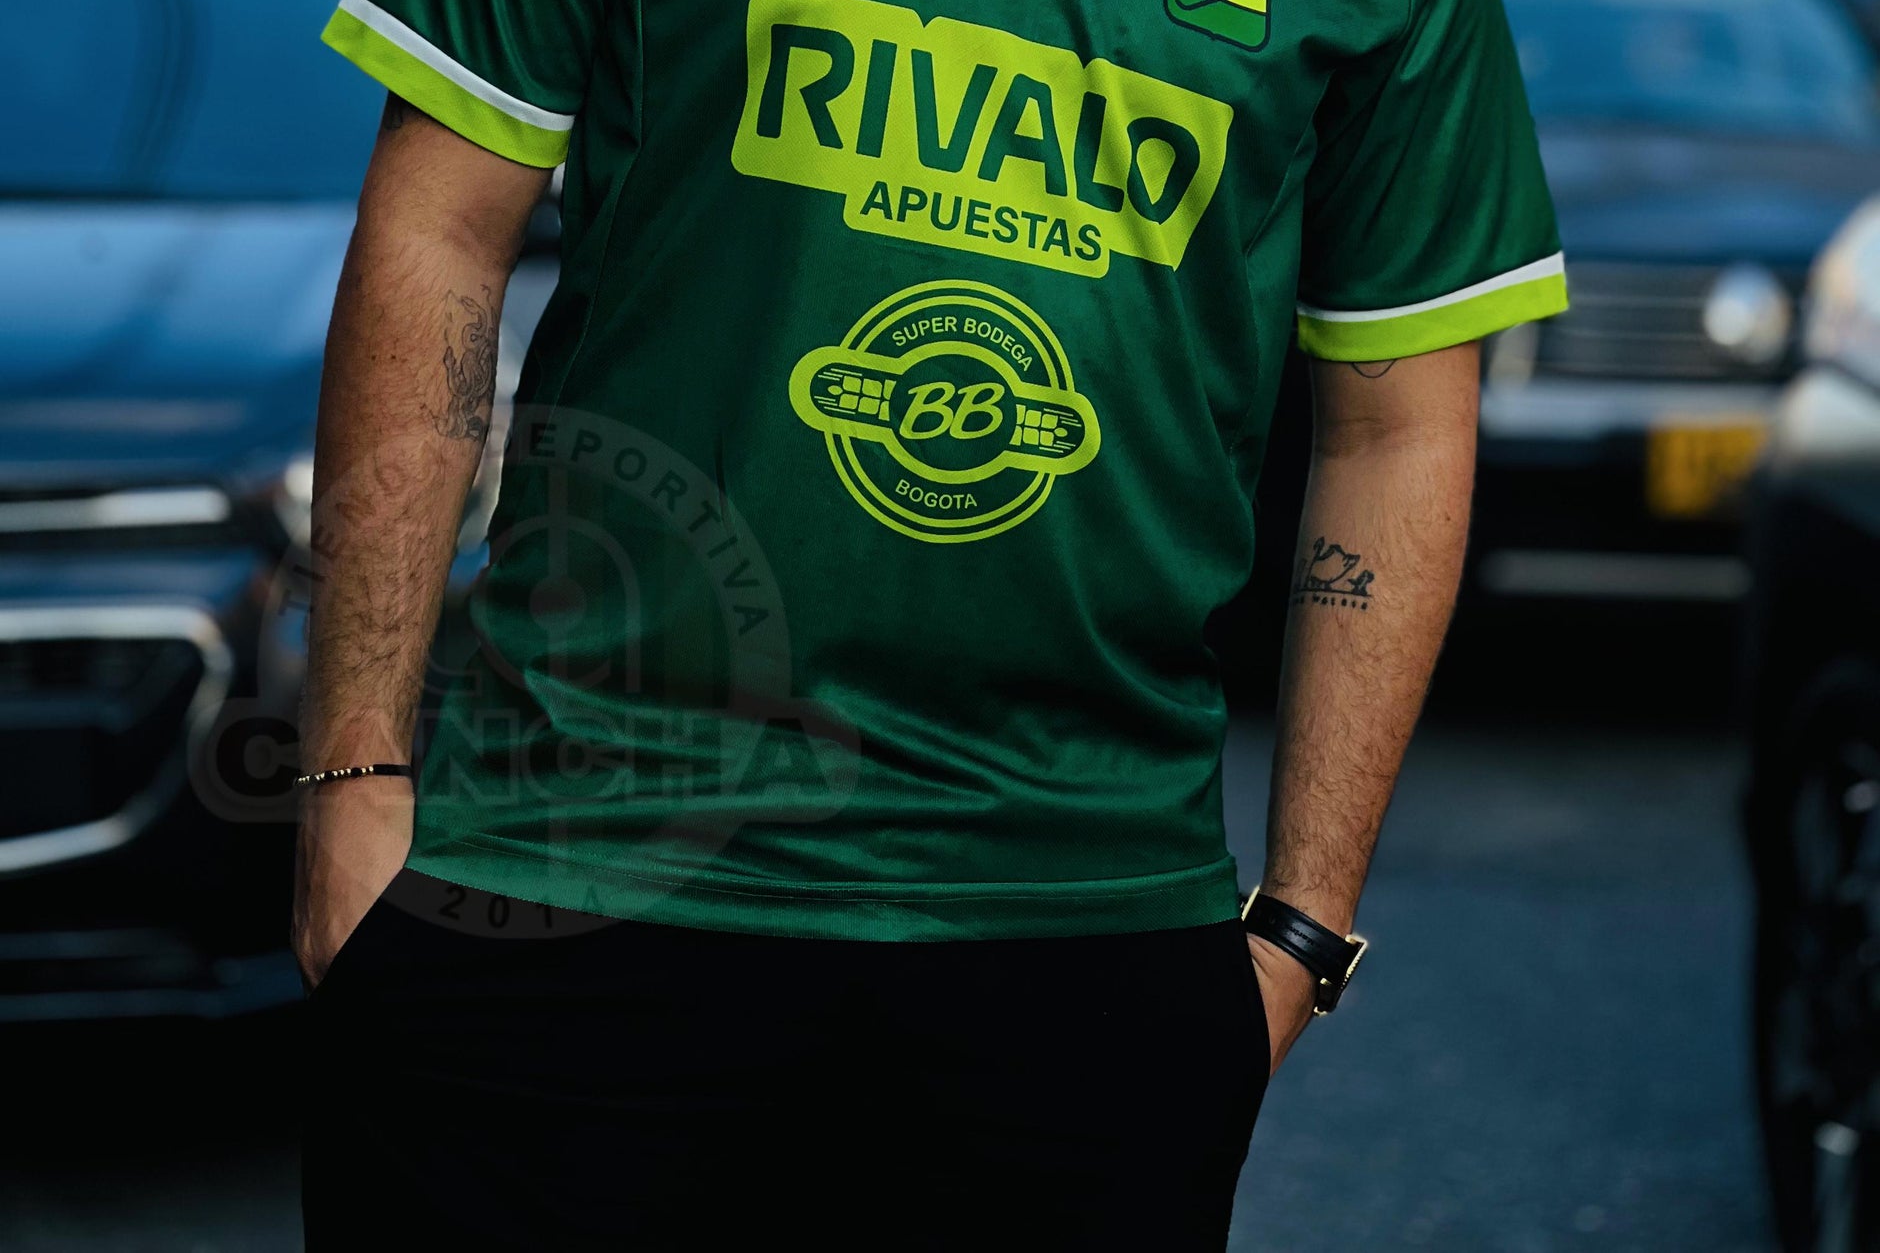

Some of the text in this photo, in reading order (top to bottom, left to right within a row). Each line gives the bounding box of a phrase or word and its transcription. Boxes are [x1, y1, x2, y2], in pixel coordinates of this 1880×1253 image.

[756, 23, 1200, 225] RIVALO
[860, 180, 1102, 262] APUESTAS
[891, 316, 1034, 372] SUPER BODEGA
[899, 381, 1006, 440] BB
[895, 478, 978, 510] BOGOTA
